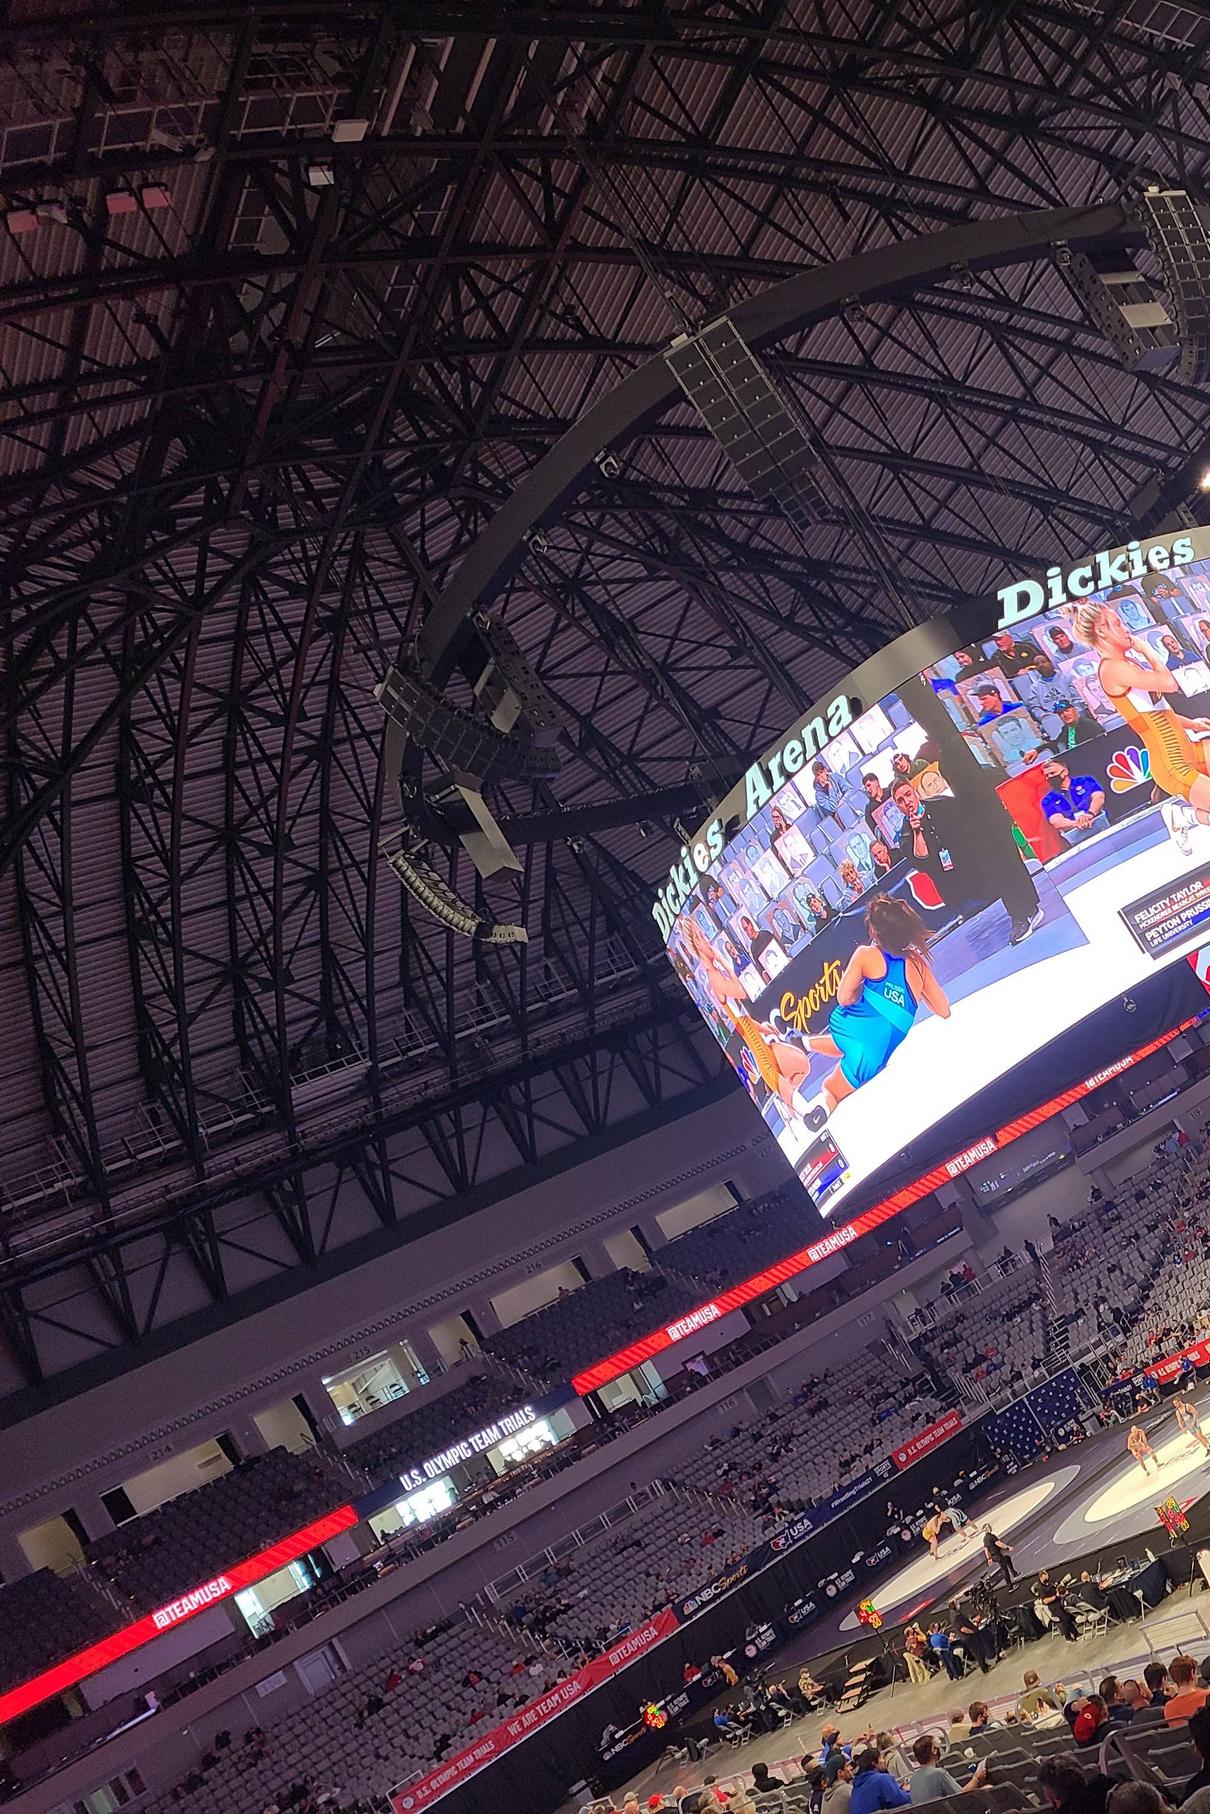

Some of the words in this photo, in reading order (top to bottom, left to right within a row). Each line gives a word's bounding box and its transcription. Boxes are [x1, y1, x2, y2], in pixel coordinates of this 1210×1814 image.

[997, 536, 1195, 630] Dickies
[745, 694, 853, 822] Arena
[652, 819, 726, 943] Dickies
[1134, 897, 1171, 924] FELICITY
[1170, 881, 1204, 903] TAYLOR
[1145, 916, 1181, 941] PEYTON
[1150, 937, 1164, 947] LIFE
[1162, 918, 1193, 940] UNIVERSITY
[884, 988, 905, 1008] USA
[948, 1137, 996, 1176] @TEAMUSA
[807, 1225, 859, 1262] @TEAMUSA
[667, 1304, 721, 1341] @TEAMUSA
[151, 1444, 173, 1461] 214
[399, 1467, 427, 1491] U.S.
[423, 1441, 472, 1478] OLYMPIC
[468, 1425, 501, 1453] TEAM
[497, 1405, 536, 1435] TRIALS
[790, 1518, 813, 1537] USA
[153, 1576, 233, 1629] @TEAMUSA
[695, 1585, 722, 1606] NBC
[716, 1564, 749, 1591] Sports
[609, 1626, 658, 1666] @TEAMUSA
[507, 1722, 523, 1737] WE
[522, 1711, 538, 1728] ARE
[535, 1694, 562, 1715] TEAM
[561, 1680, 582, 1700] USA
